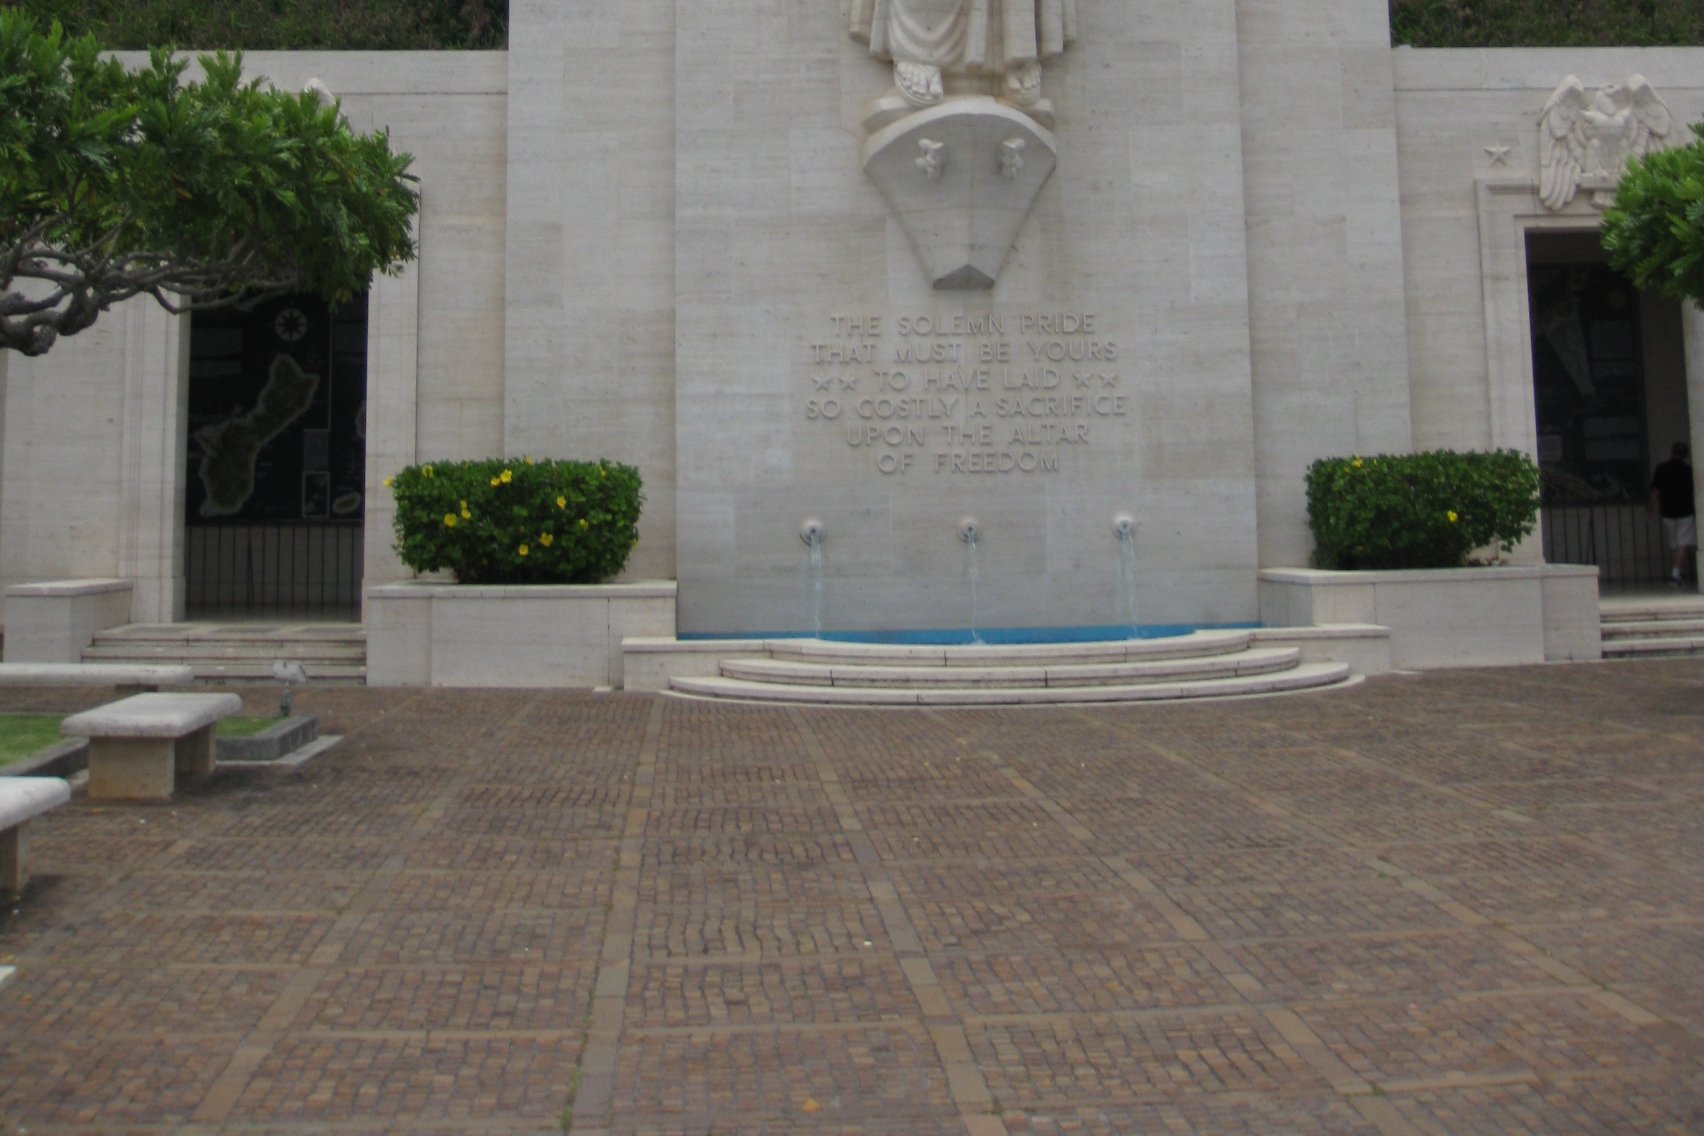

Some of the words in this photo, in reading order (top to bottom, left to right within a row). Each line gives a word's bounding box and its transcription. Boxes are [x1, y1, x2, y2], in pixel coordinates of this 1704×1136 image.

[831, 315, 881, 337] THE
[900, 315, 1004, 336] SOLEMN
[1021, 314, 1095, 335] PRIDE
[811, 344, 876, 365] THAT
[896, 343, 962, 364] MUST
[980, 342, 1010, 363] BE
[1028, 341, 1118, 361] YOURS
[875, 371, 909, 391] TO
[924, 370, 990, 391] HAVE
[1004, 368, 1060, 390] LAID
[806, 399, 841, 420] SO
[857, 398, 958, 419] COSTLY
[974, 398, 986, 418] A
[996, 396, 1127, 417] SACRIFICE
[846, 426, 925, 447] UPON
[943, 425, 992, 446] THE
[1009, 424, 1090, 444] ALTAR
[878, 454, 914, 474] OF
[935, 452, 1060, 473] FREEDOM
